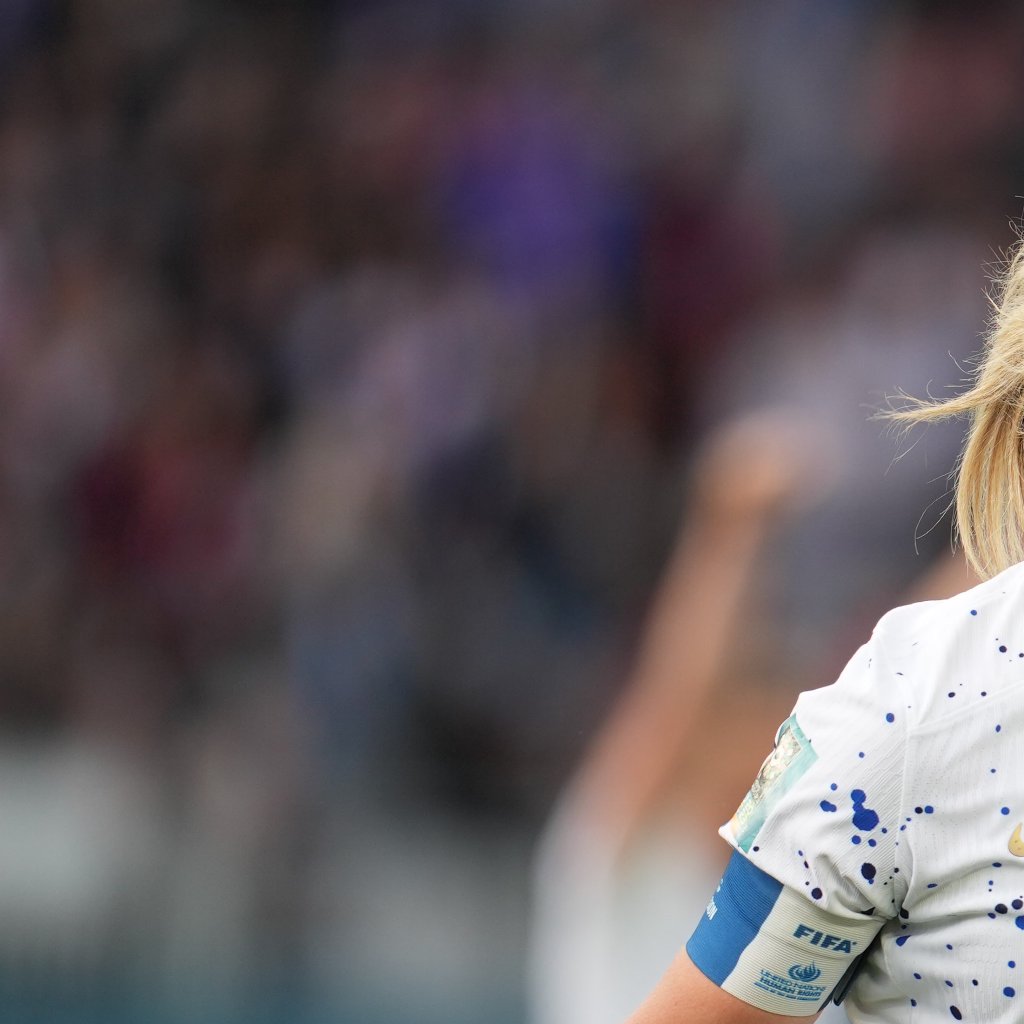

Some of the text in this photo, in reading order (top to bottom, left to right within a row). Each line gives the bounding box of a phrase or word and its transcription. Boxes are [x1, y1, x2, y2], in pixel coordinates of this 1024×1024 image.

[793, 924, 852, 954] FIFA
[760, 969, 793, 987] UNITED
[760, 976, 796, 995] HUMAN
